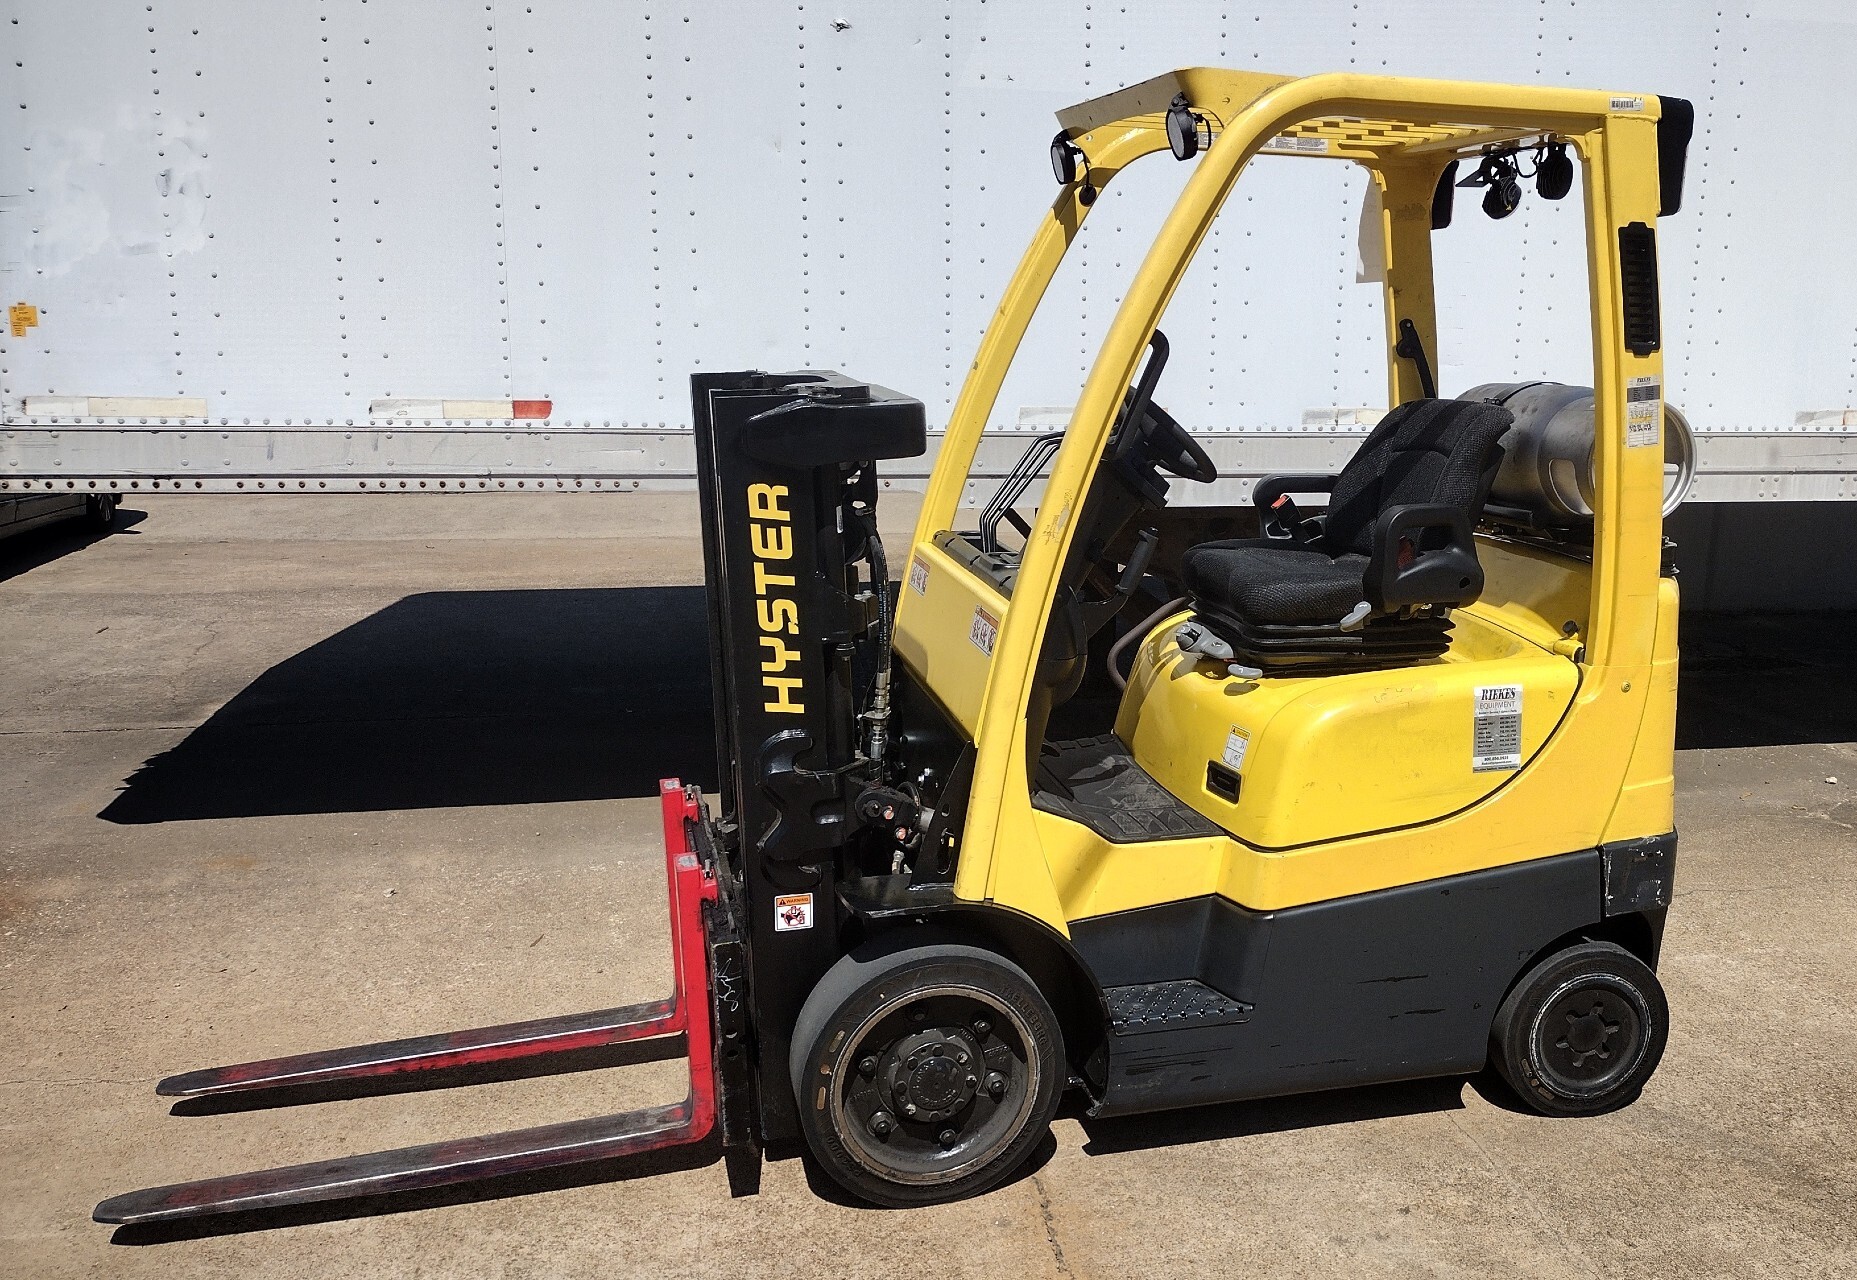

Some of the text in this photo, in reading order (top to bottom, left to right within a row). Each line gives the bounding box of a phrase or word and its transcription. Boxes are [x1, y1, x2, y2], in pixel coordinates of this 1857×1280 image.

[747, 483, 805, 713] HYSTER
[1481, 687, 1516, 700] RIEKES
[1479, 701, 1516, 709] EQUIPMENT
